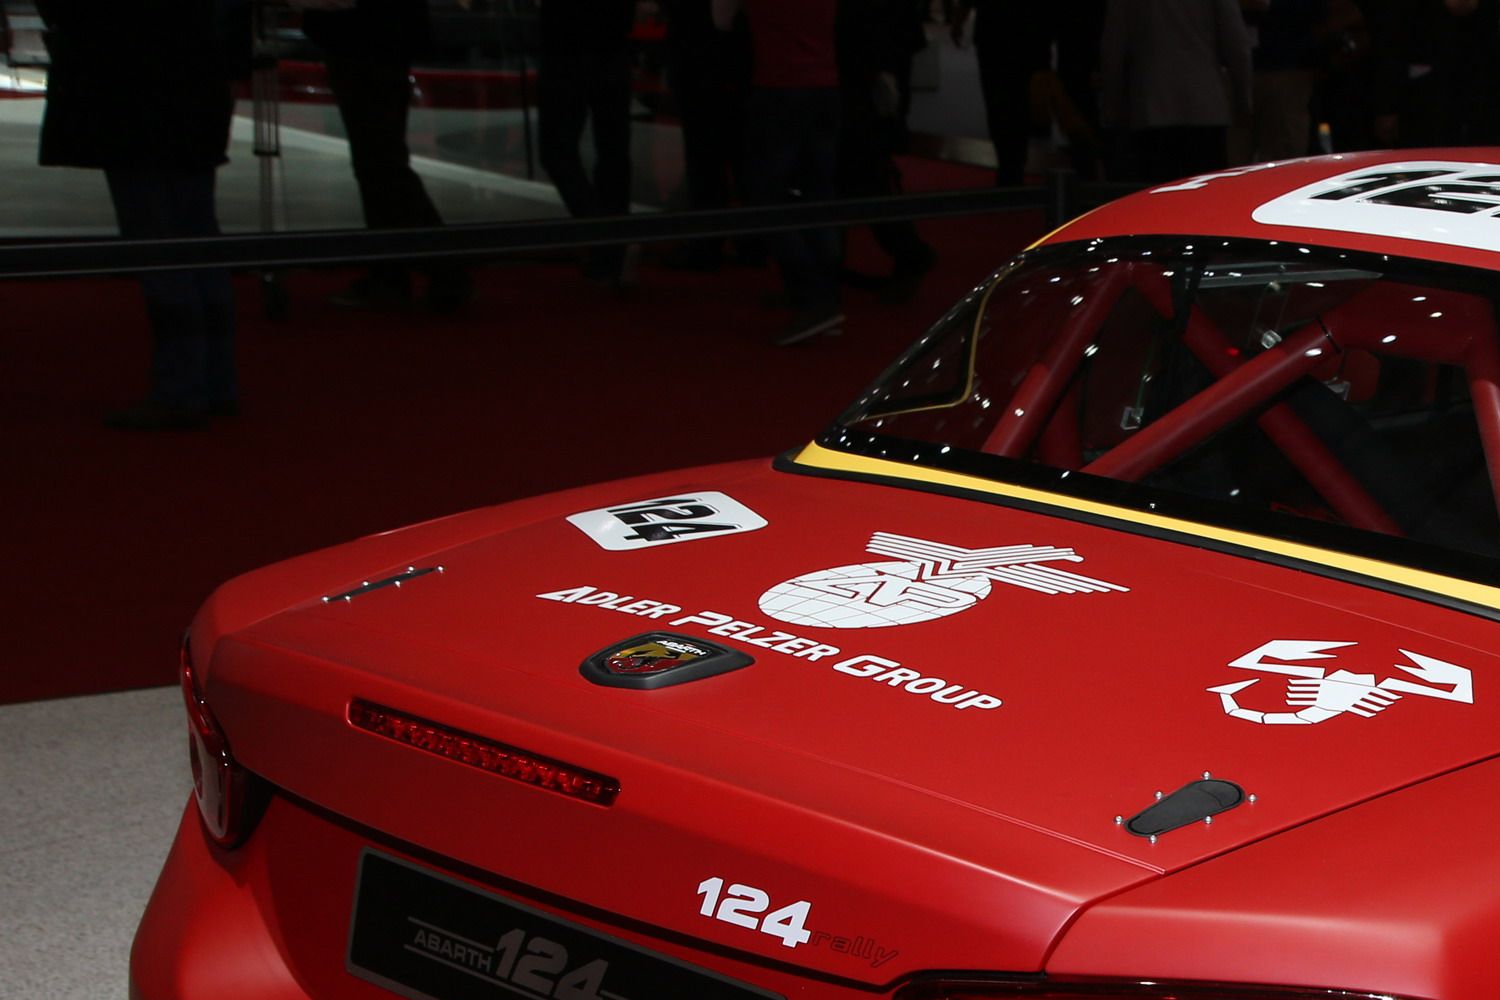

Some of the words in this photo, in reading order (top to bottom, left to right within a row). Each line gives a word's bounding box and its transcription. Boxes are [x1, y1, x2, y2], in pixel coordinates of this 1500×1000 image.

[606, 498, 744, 542] 124
[535, 585, 682, 620] ADLER
[668, 610, 840, 661] PELZER
[832, 654, 1002, 710] GROUP
[413, 927, 493, 975] ABARTH
[696, 876, 812, 948] 124
[811, 929, 900, 968] rally
